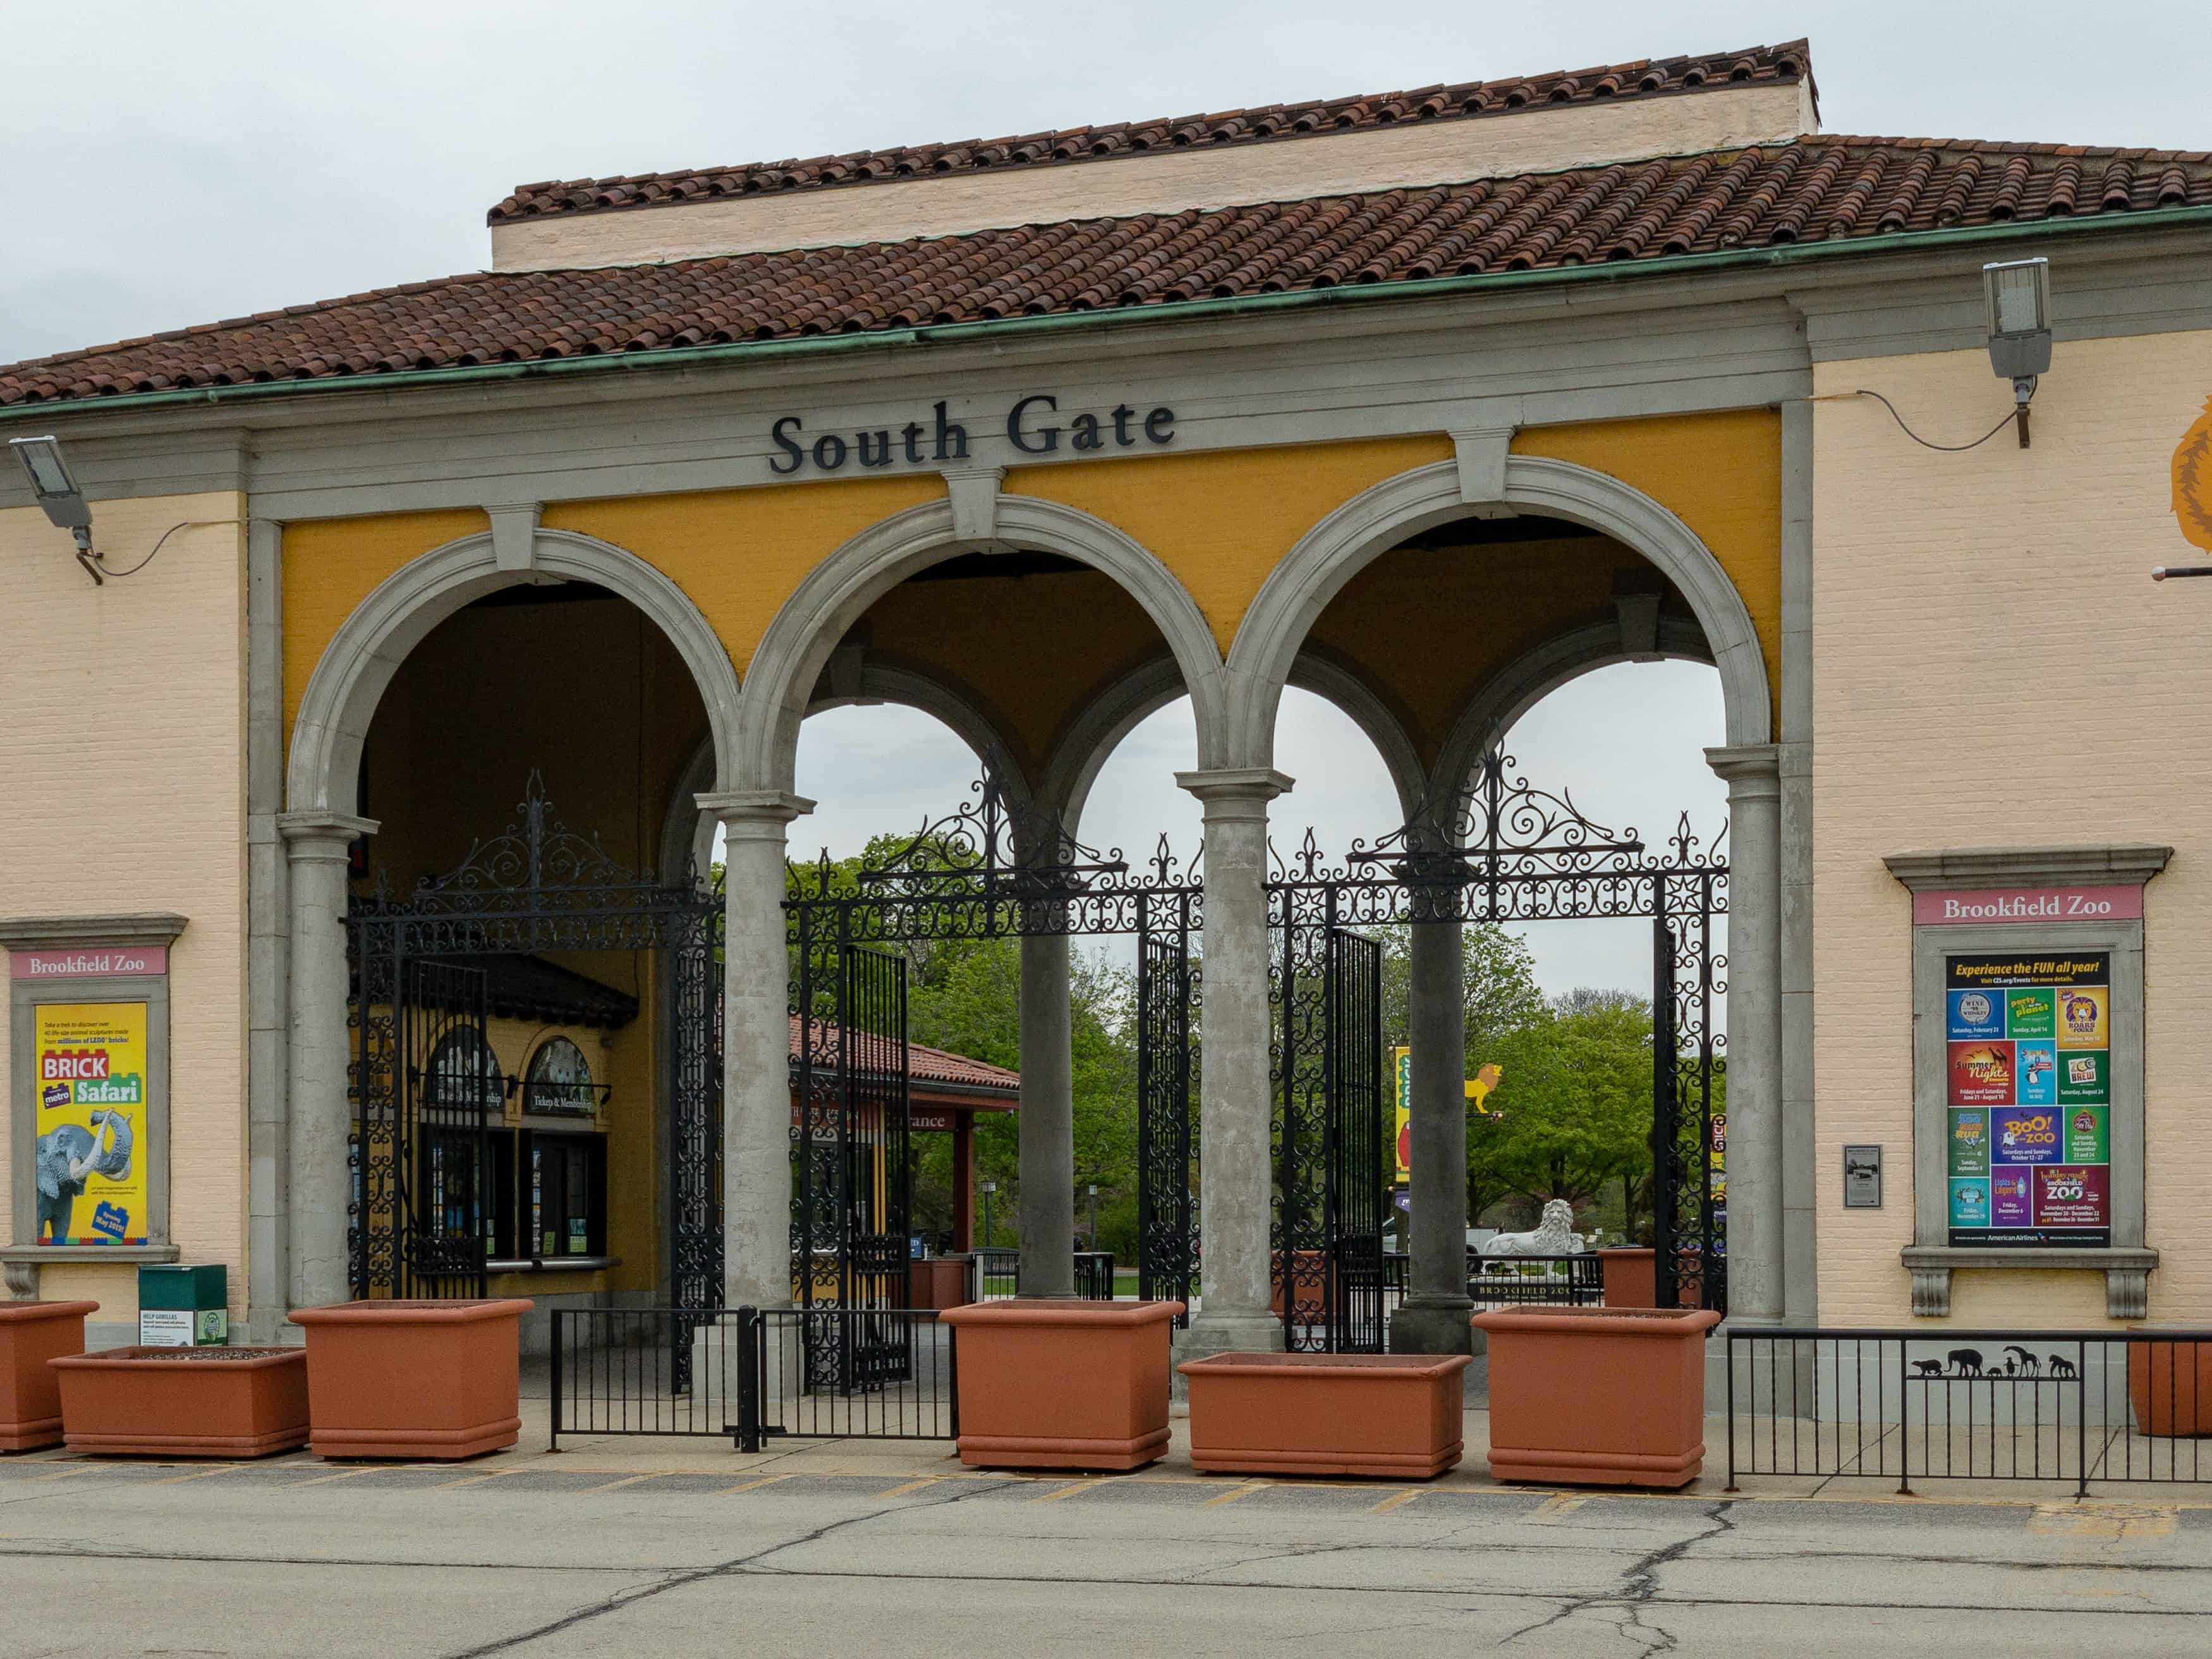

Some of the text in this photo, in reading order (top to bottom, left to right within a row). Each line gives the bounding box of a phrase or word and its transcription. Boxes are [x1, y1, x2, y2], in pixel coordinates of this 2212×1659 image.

[769, 395, 1176, 475] South Gate
[1943, 895, 2112, 918] Brookfield Zoo
[30, 955, 145, 974] Brookfield Zoo
[1956, 961, 2100, 978] Experience the FUN all year!
[45, 1057, 107, 1078] BRICK
[1957, 1061, 1994, 1069] Summer
[1970, 1066, 2009, 1083] Nights
[2072, 1071, 2094, 1082] BREW
[45, 1091, 69, 1103] metro
[78, 1081, 137, 1102] Safari
[554, 1097, 560, 1107] &
[561, 1097, 592, 1112] Membership
[2026, 1132, 2055, 1143] ZOO
[2046, 1186, 2083, 1201] ZOO
